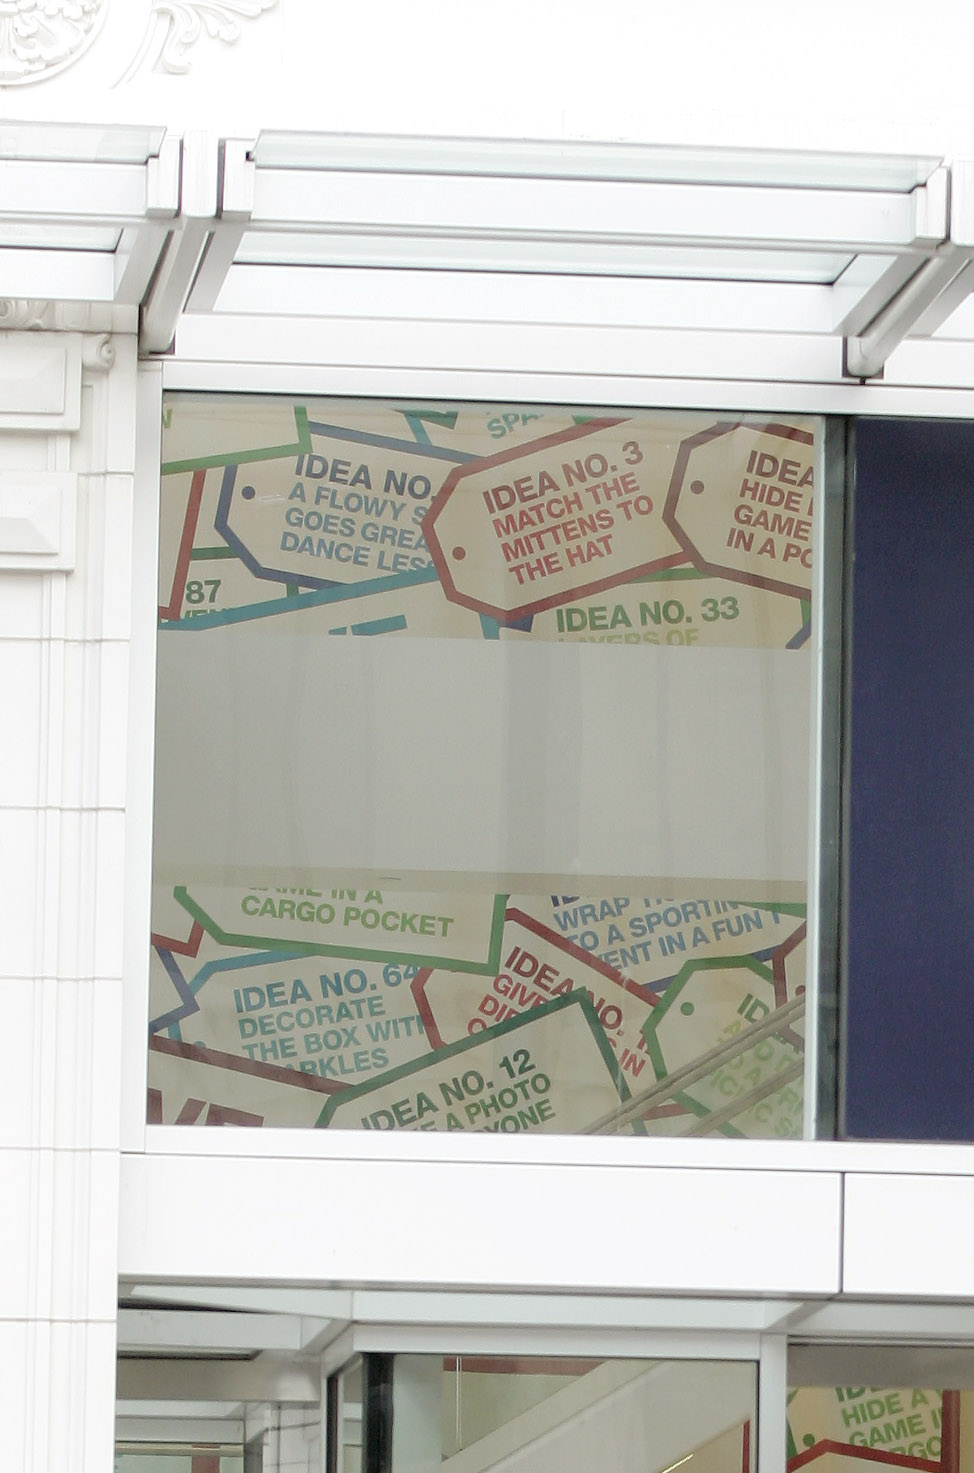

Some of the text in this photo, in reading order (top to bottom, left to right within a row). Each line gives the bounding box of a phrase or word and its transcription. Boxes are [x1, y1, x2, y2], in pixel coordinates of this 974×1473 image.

[295, 454, 372, 489] IDEA
[482, 441, 644, 514] IDEA NO. 3
[745, 450, 814, 488] IDEA
[288, 482, 307, 502] A
[314, 486, 406, 520] FLOWY
[492, 472, 640, 538] MATCH THE
[739, 479, 804, 513] HIDE
[285, 507, 355, 537] GOES
[501, 495, 653, 563] MITTENS TO
[734, 504, 813, 542] GAME
[280, 531, 434, 572] DANCE LES
[508, 534, 613, 585] THE HAT
[726, 527, 755, 552] IN
[757, 537, 776, 559] A
[185, 579, 222, 603] 87
[557, 596, 740, 633] IDEA NO. 33
[241, 895, 455, 937] CARGO POCKET
[553, 897, 631, 931] WRAP
[658, 934, 686, 957] IN
[692, 925, 710, 948] A
[712, 909, 763, 941] FUN
[607, 923, 625, 945] A
[504, 946, 574, 997] IDEA
[233, 978, 311, 1014] IDEA
[320, 968, 377, 1001] NO.
[237, 995, 385, 1039] DECORATE
[242, 1038, 298, 1062] THE
[303, 1027, 361, 1055] BOX
[286, 1048, 389, 1078] RKLES
[361, 1049, 536, 1131] IDEA NO. 12
[464, 1073, 551, 1125] PHOTO
[475, 1098, 556, 1133] YONE
[841, 1389, 928, 1428] HIDE A
[849, 1414, 926, 1448] GAME
